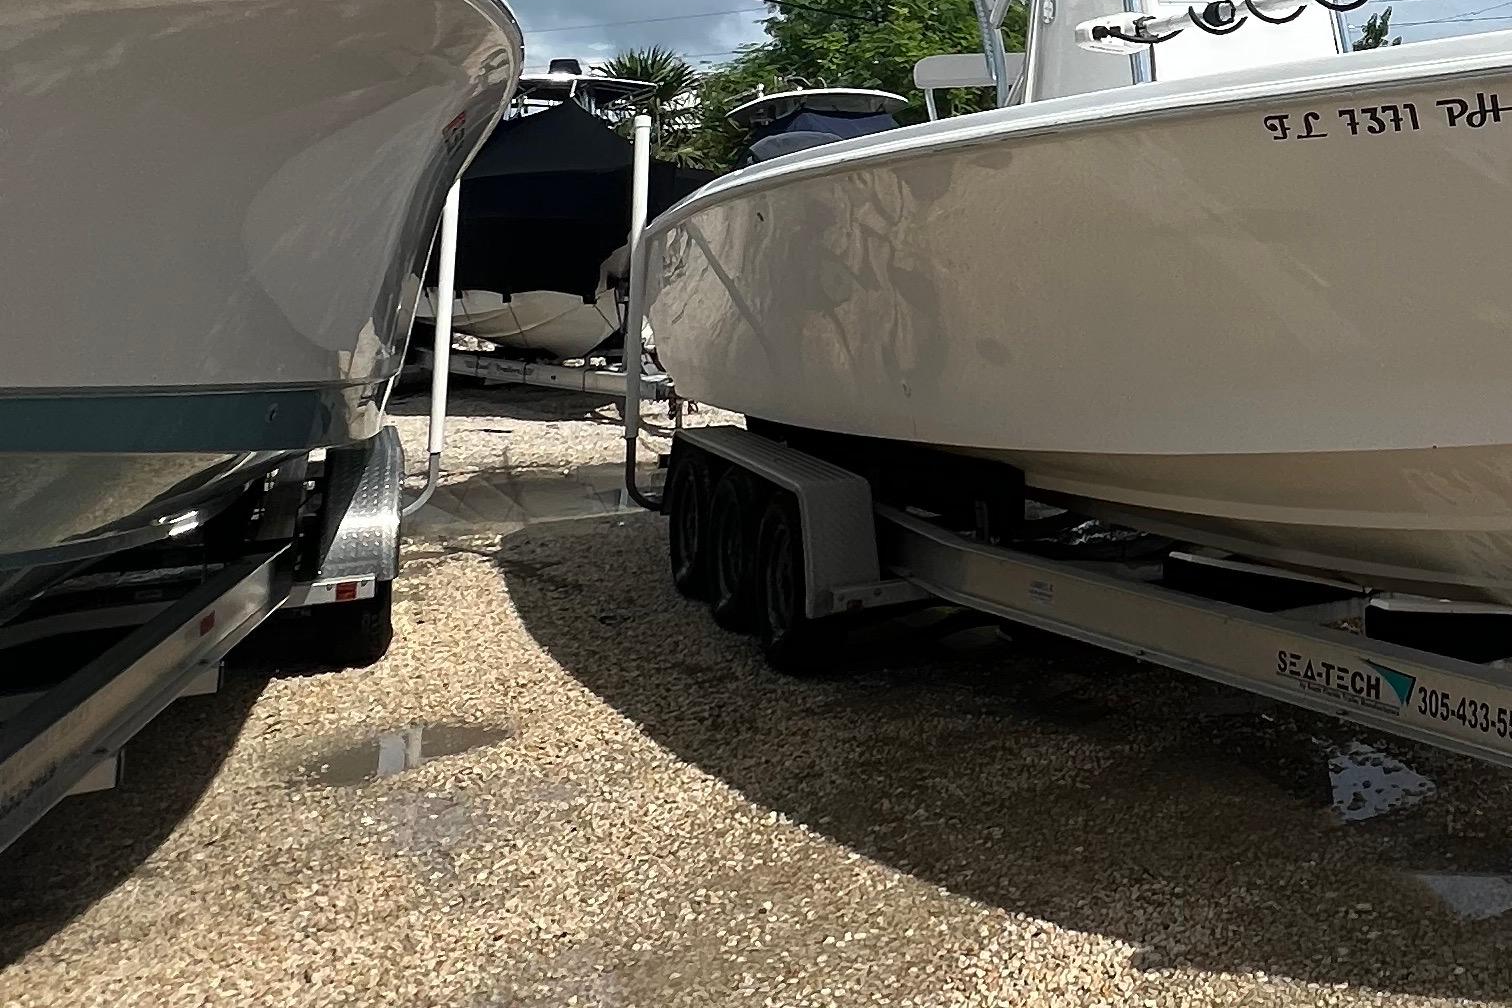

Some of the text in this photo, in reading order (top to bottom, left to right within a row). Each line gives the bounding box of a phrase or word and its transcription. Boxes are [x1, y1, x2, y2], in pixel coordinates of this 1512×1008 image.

[1263, 111, 1328, 141] FL
[1338, 103, 1420, 135] 7371
[1277, 650, 1381, 700] SEA-TECH
